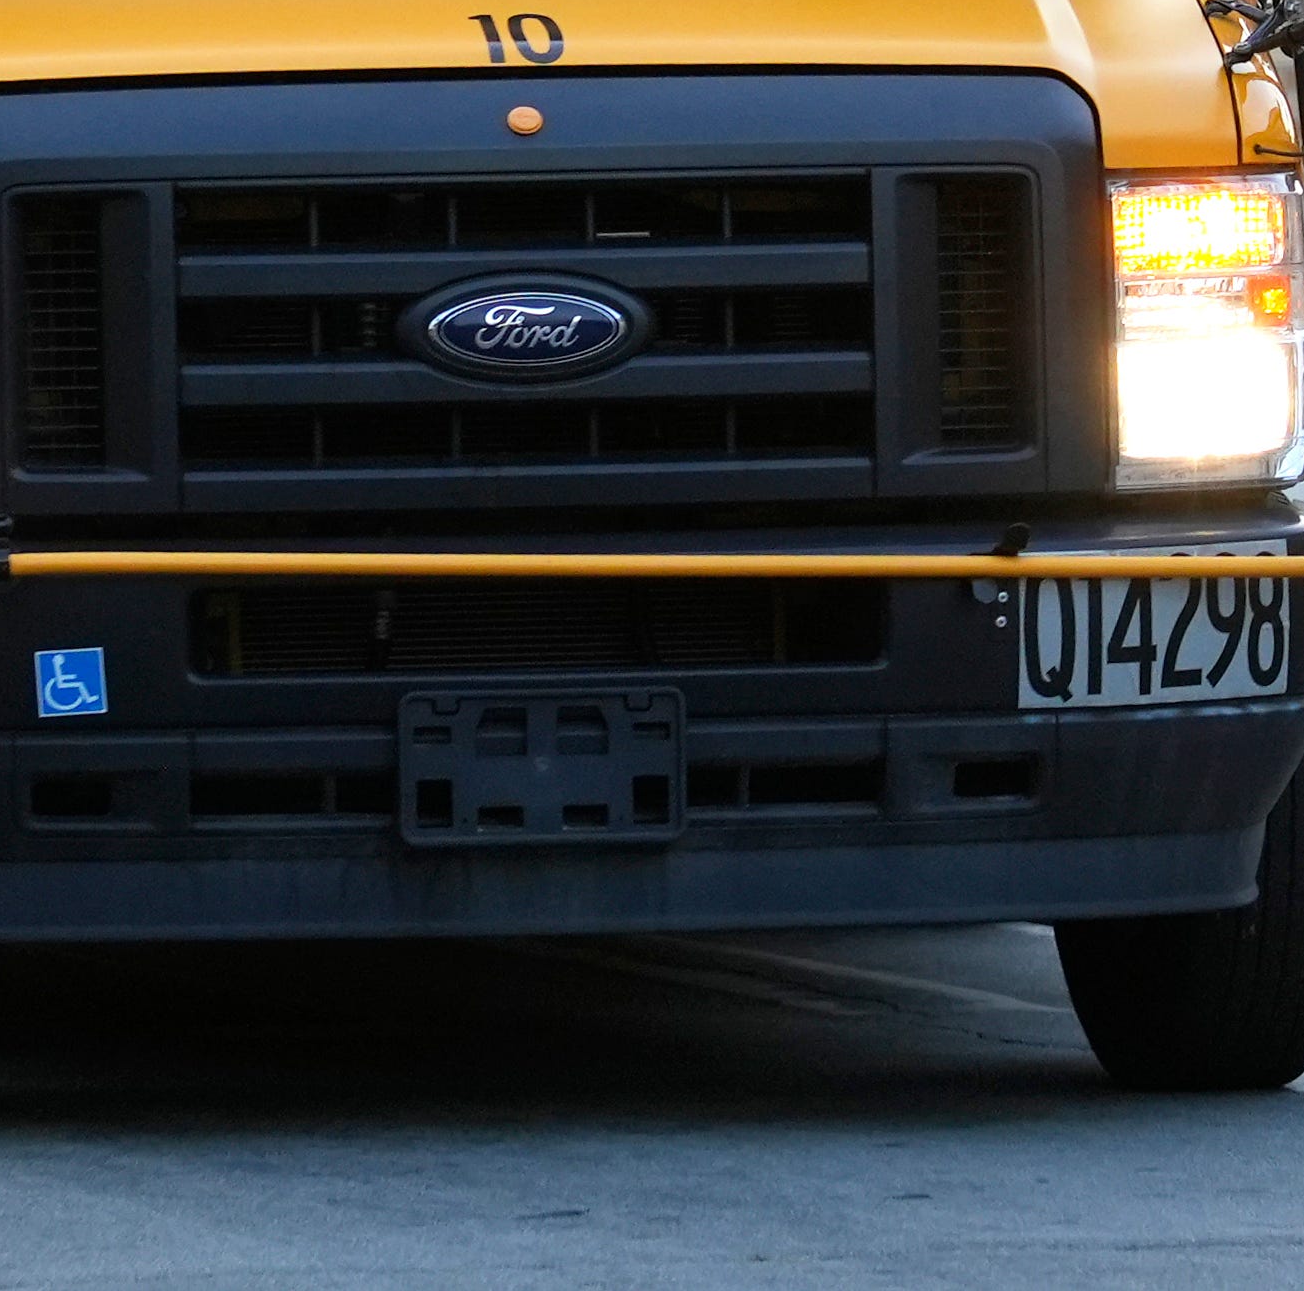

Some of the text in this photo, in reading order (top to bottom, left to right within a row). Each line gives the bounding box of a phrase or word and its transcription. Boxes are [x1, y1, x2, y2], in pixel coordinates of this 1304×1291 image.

[468, 13, 565, 64] 10
[474, 305, 581, 350] Ford
[1024, 551, 1285, 703] Q14298
